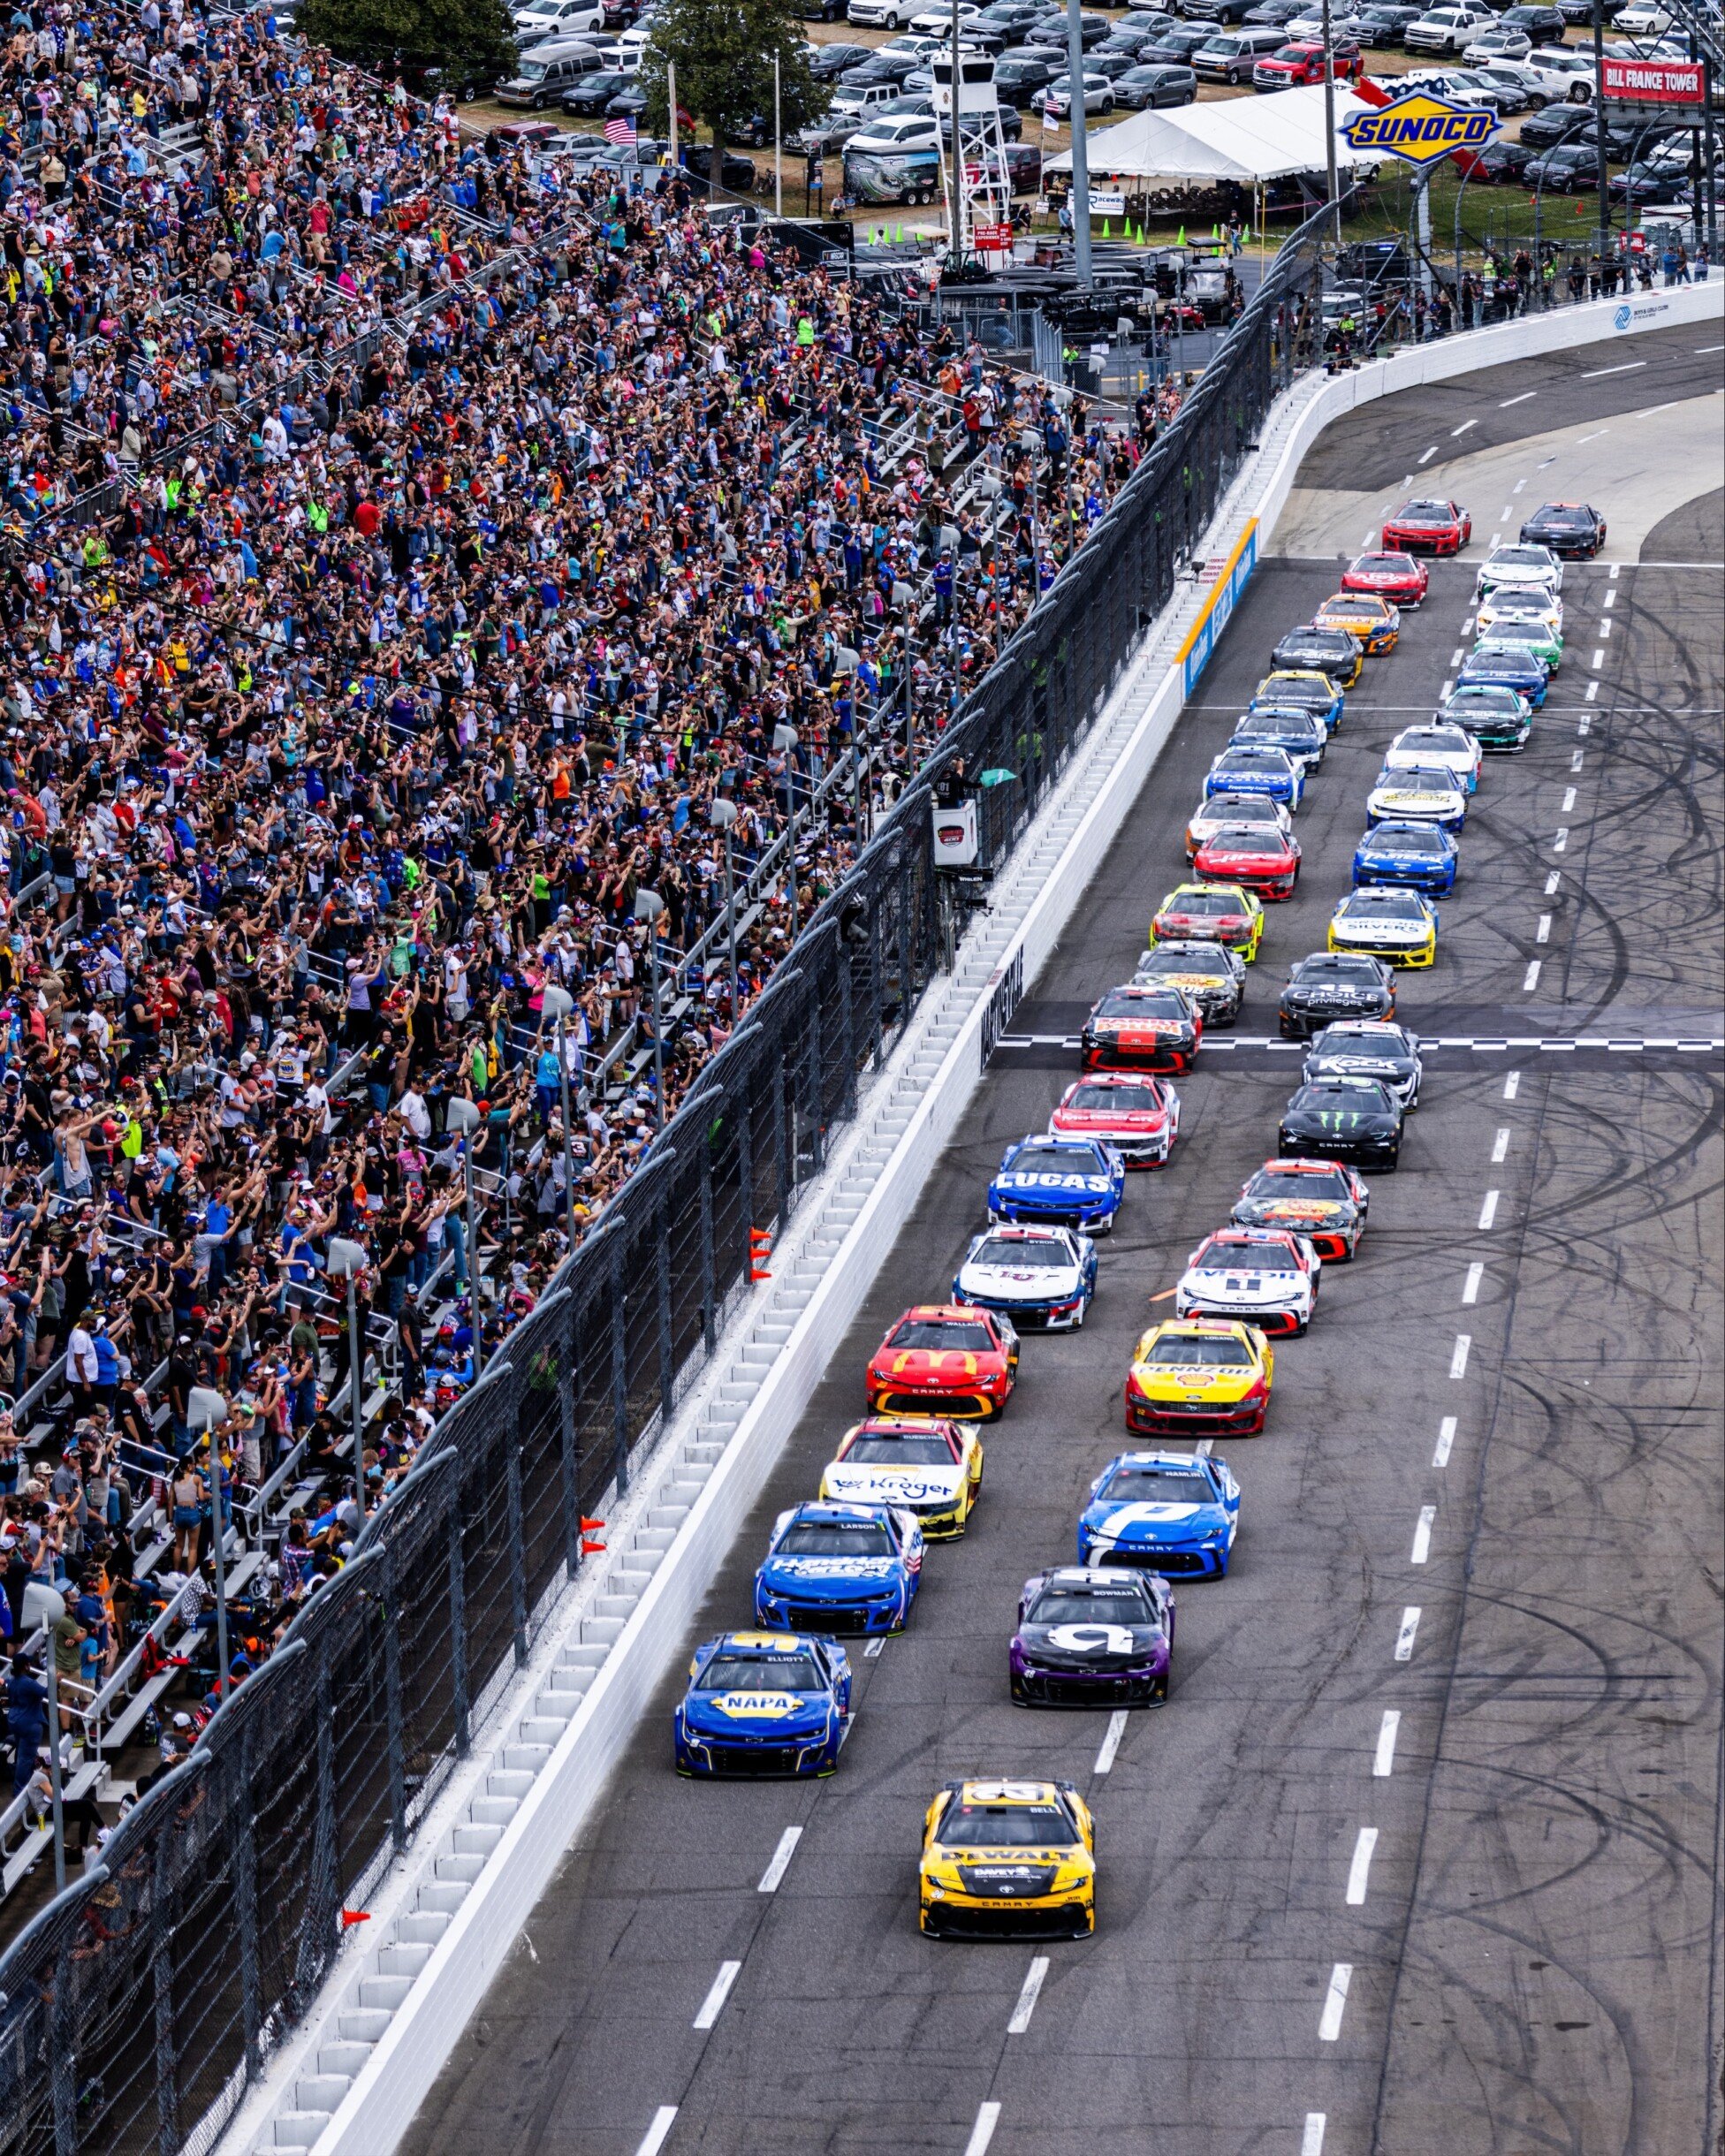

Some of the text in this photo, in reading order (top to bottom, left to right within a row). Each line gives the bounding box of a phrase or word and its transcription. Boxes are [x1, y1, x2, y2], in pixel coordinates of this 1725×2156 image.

[1607, 69, 1698, 92] BILL FRANCE TOWER
[1355, 116, 1489, 143] SUNOCO
[1293, 991, 1379, 1002] CHOICE
[571, 1141, 587, 1153] 3
[996, 1172, 1110, 1193] LUCAS
[1196, 1269, 1296, 1279] Mobil
[1139, 1366, 1253, 1377] PENNZOIL
[870, 1476, 953, 1499] Kroger
[768, 1598, 778, 1607] 5
[727, 1697, 789, 1709] NAPA
